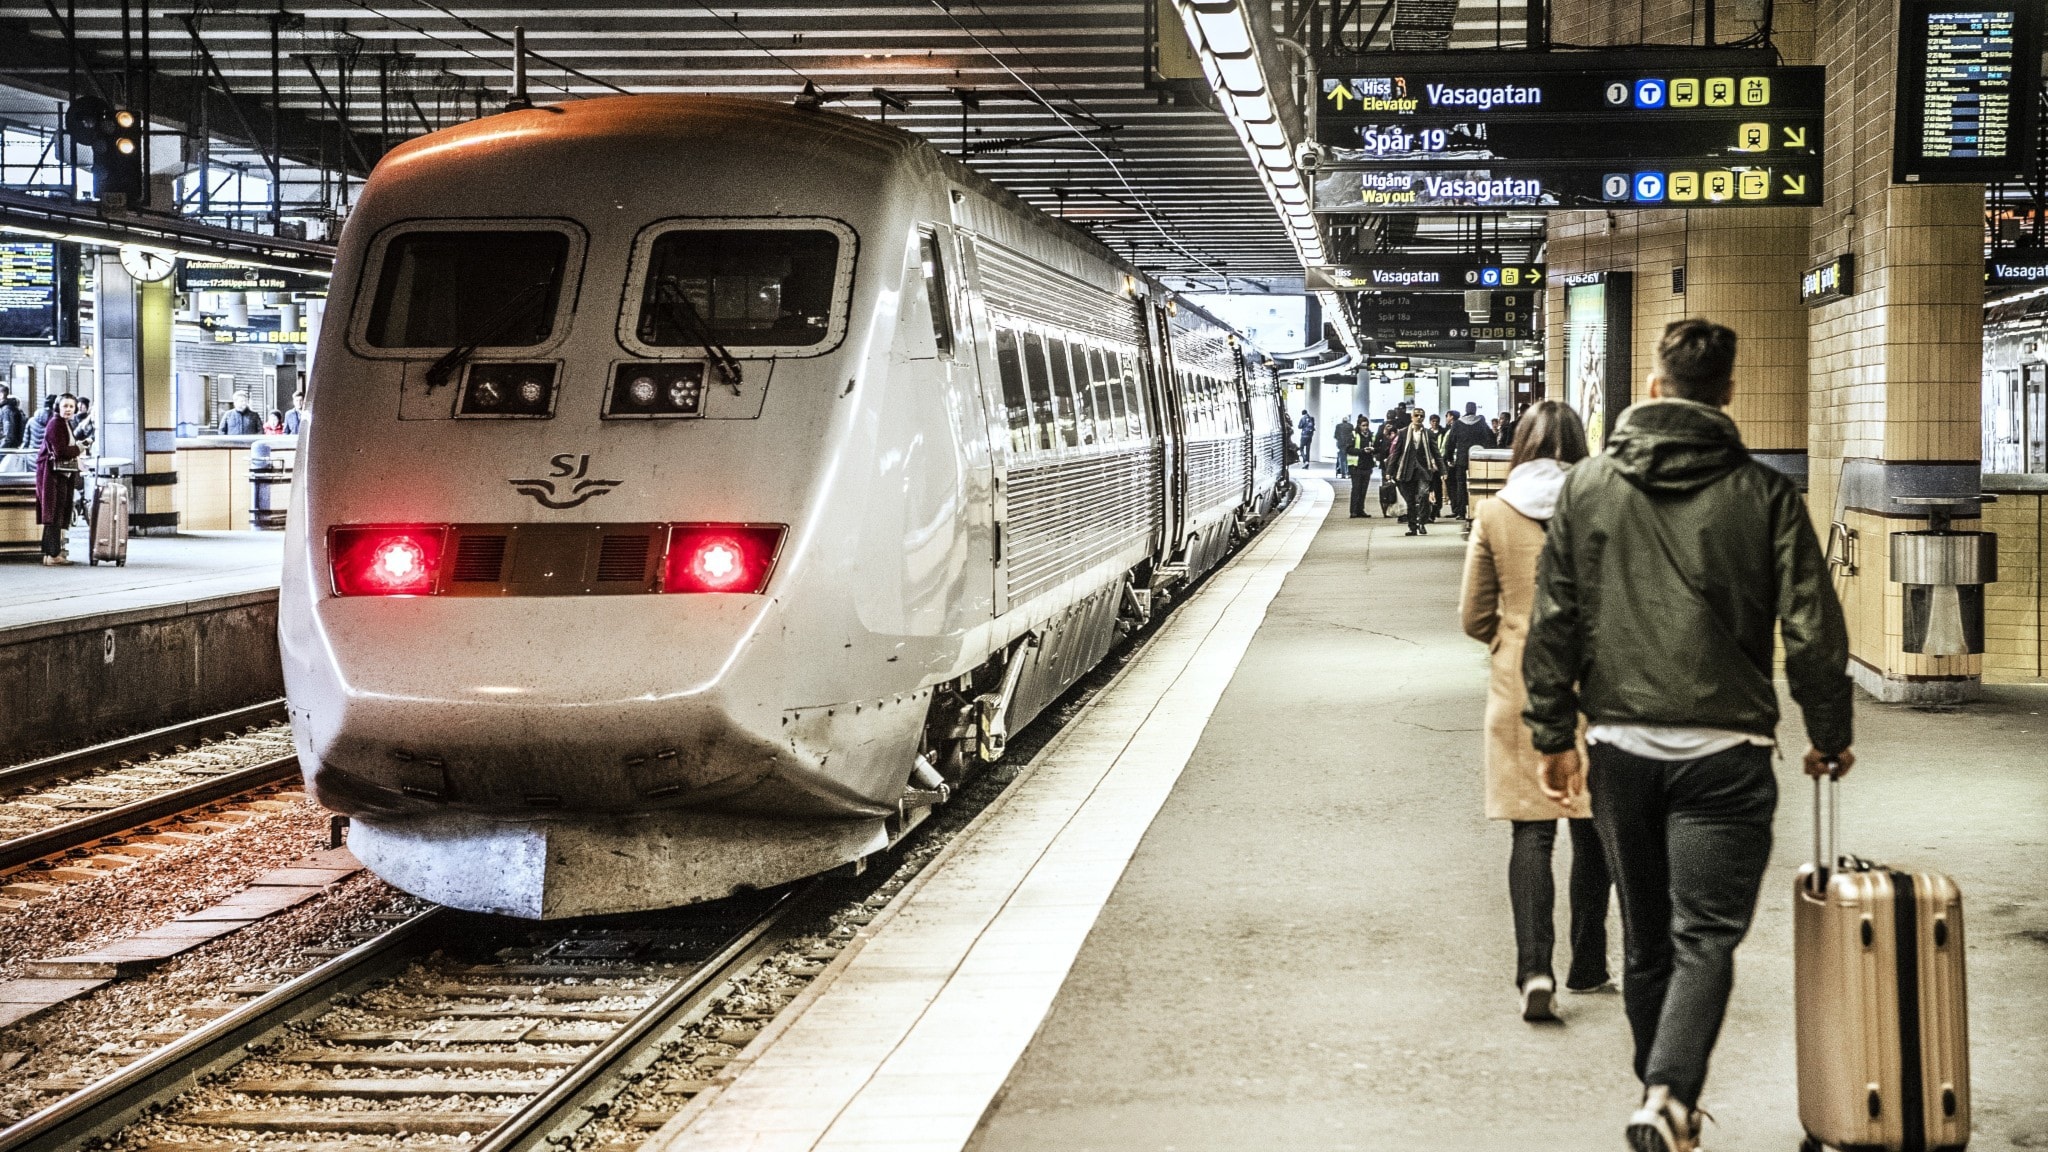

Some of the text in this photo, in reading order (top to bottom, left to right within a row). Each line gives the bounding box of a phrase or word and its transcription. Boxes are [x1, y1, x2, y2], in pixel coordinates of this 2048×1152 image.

[1363, 81, 1391, 94] Hiss
[1426, 83, 1541, 109] Vasagatan
[1363, 97, 1418, 111] Elevator
[1364, 127, 1445, 155] Spår 19
[1362, 173, 1411, 189] Utgång
[1426, 177, 1540, 202] Vasagatan
[1362, 190, 1415, 205] Way out
[1373, 270, 1439, 285] Vasagatan
[1378, 297, 1410, 306] Spår 17a
[1378, 313, 1411, 322] Spår 18a
[1400, 329, 1439, 338] Vasagatan
[549, 453, 590, 479] SJ
